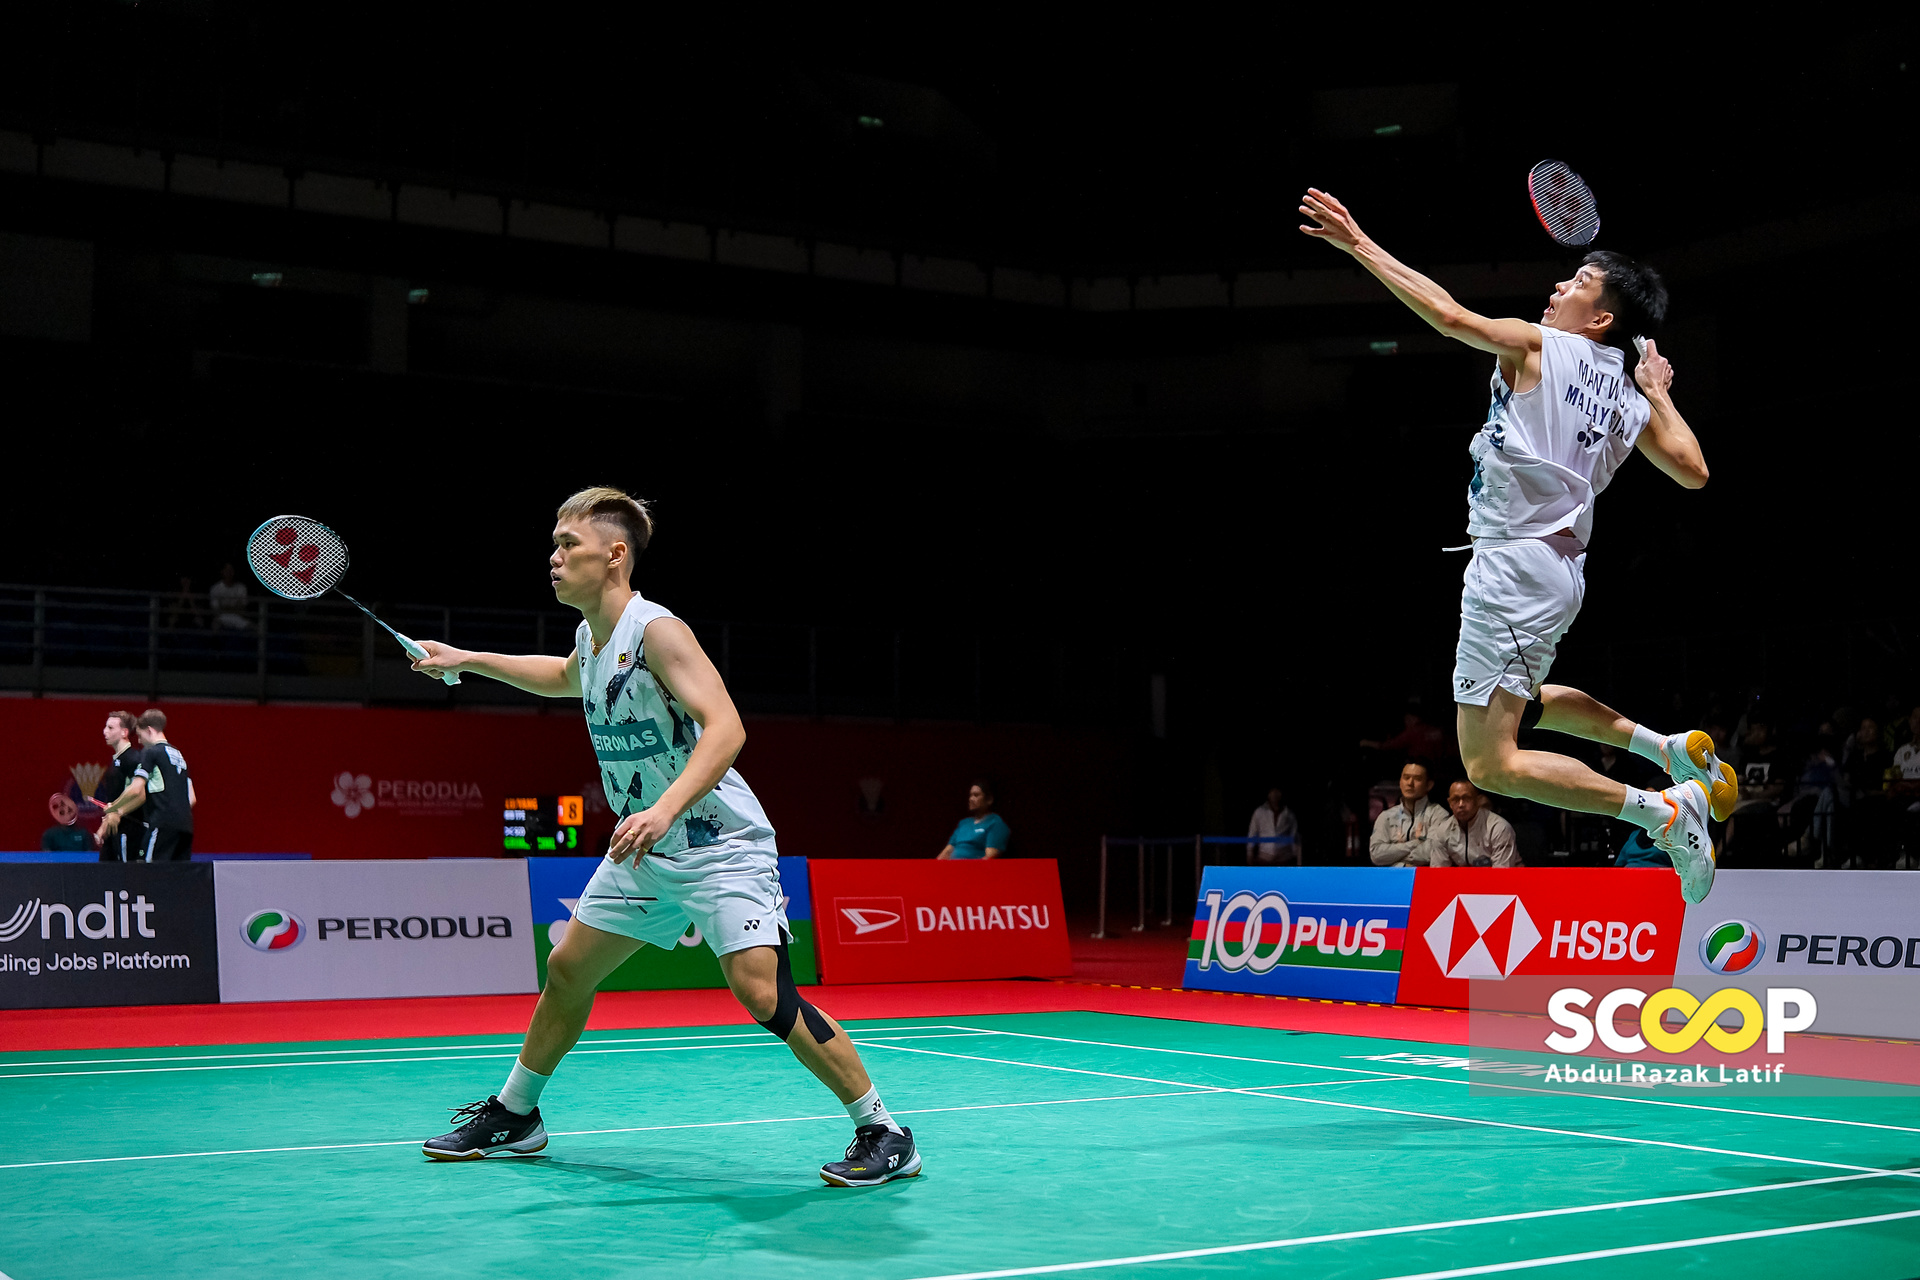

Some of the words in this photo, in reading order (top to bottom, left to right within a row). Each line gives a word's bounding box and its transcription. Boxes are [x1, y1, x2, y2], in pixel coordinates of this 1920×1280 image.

[1578, 359, 1605, 396] MAN
[593, 729, 658, 753] ETRONAS
[378, 780, 484, 800] PERODUA
[568, 803, 577, 820] 8
[915, 905, 1050, 932] DAIHATSU
[1199, 892, 1291, 972] 100
[1293, 916, 1389, 957] PLUS
[1549, 920, 1658, 962] HSBC
[46, 953, 98, 971] Jobs
[103, 951, 191, 970] Platform
